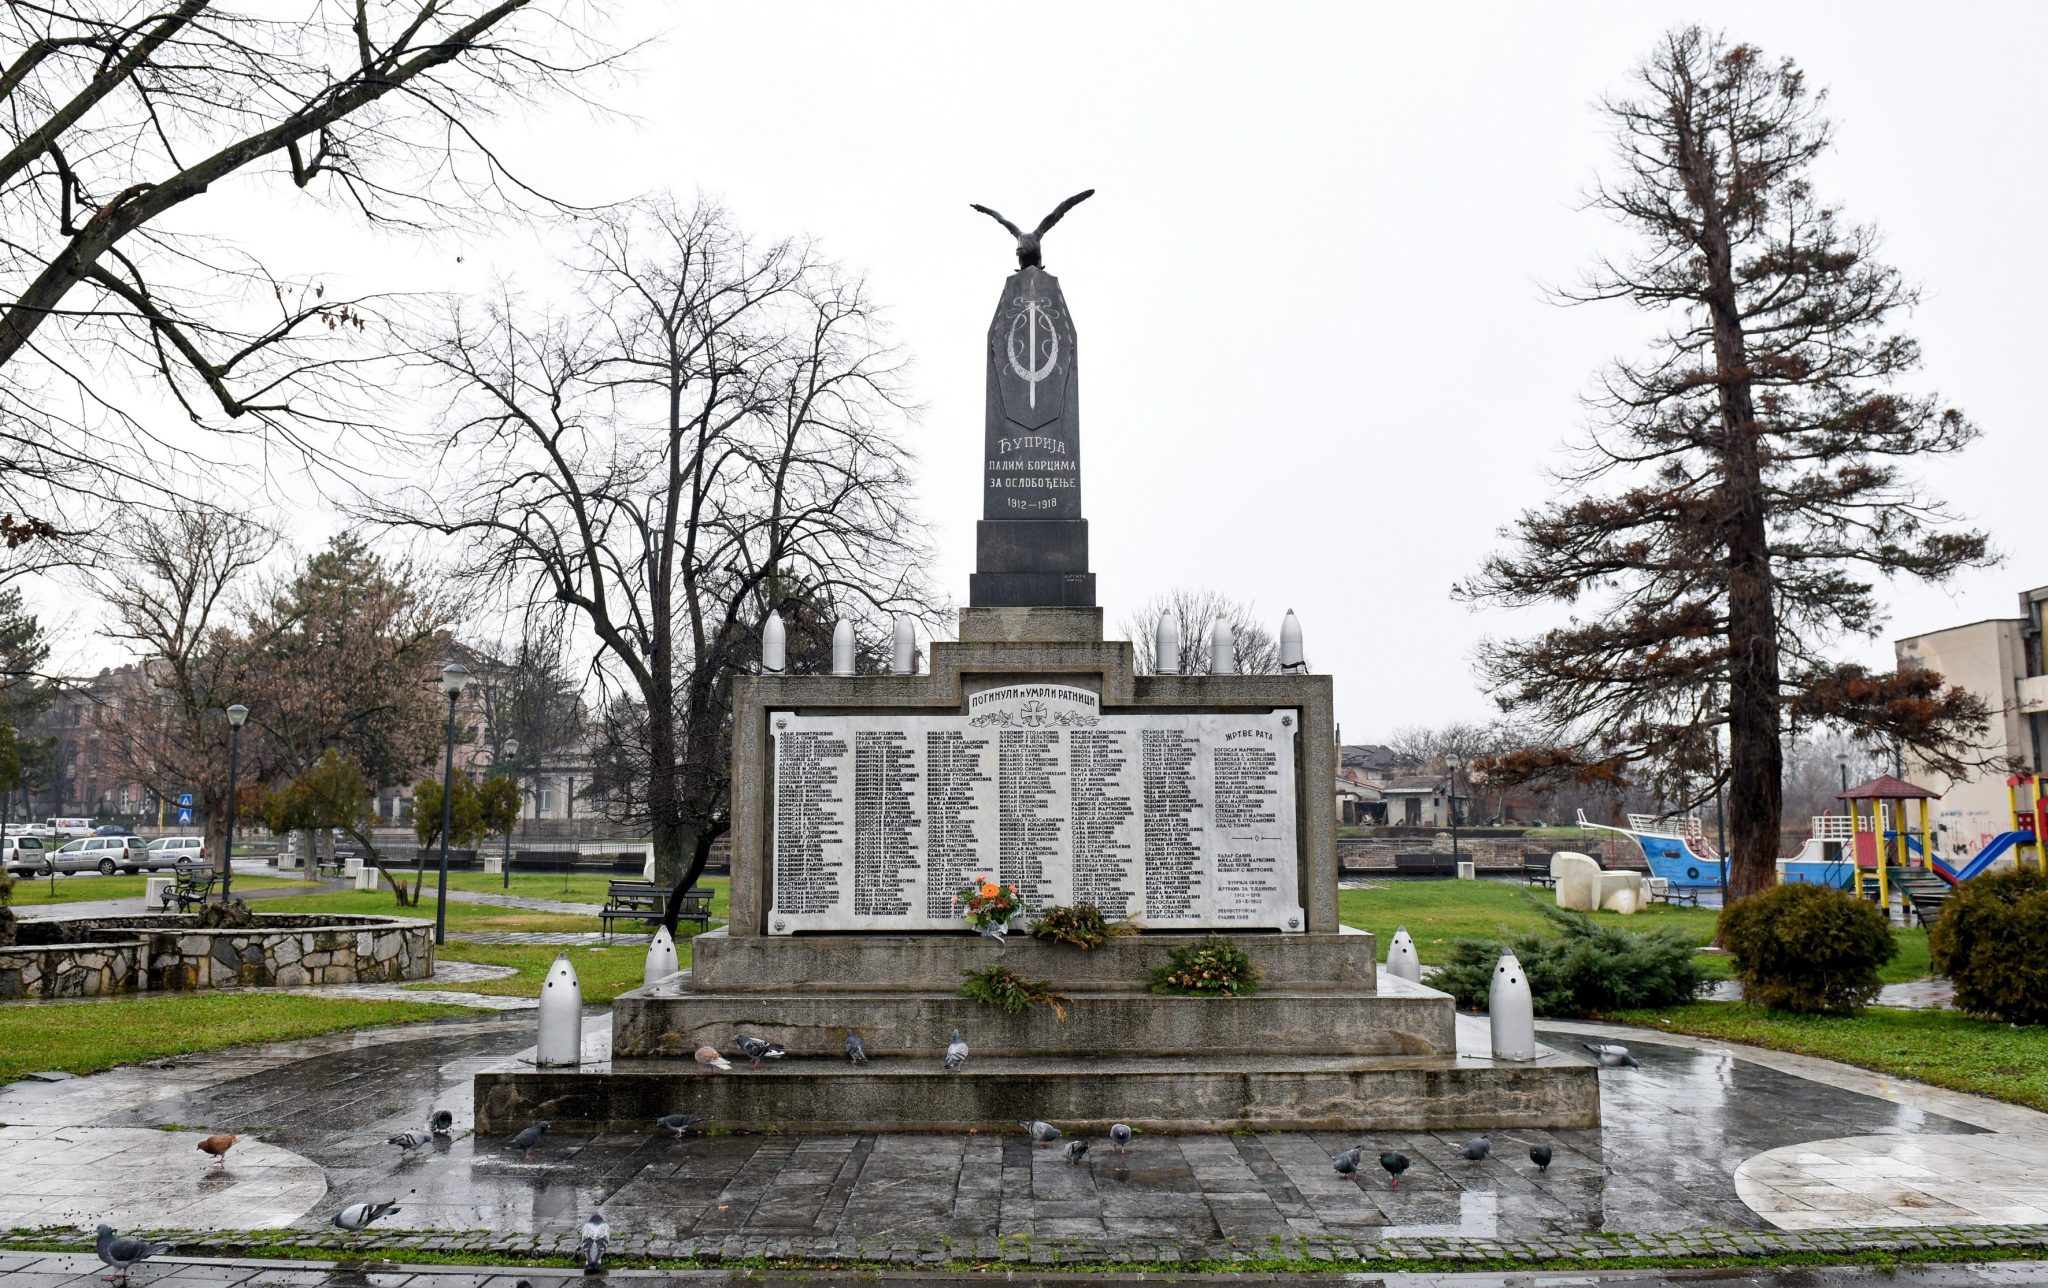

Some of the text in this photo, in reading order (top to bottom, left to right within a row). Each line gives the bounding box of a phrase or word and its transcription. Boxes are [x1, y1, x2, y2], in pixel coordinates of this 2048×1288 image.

[989, 461, 1076, 471] ПАЛИМ БОРЦИМА
[990, 478, 1076, 489] ЗА ОСЛОБОЂЕЊЕ
[972, 688, 1018, 707] ПОГИНУЛИ
[1026, 688, 1056, 698] УМРЛИ
[1058, 689, 1095, 707] РАТНИЦИ
[1225, 730, 1273, 741] ЖРТВЕ РАТА
